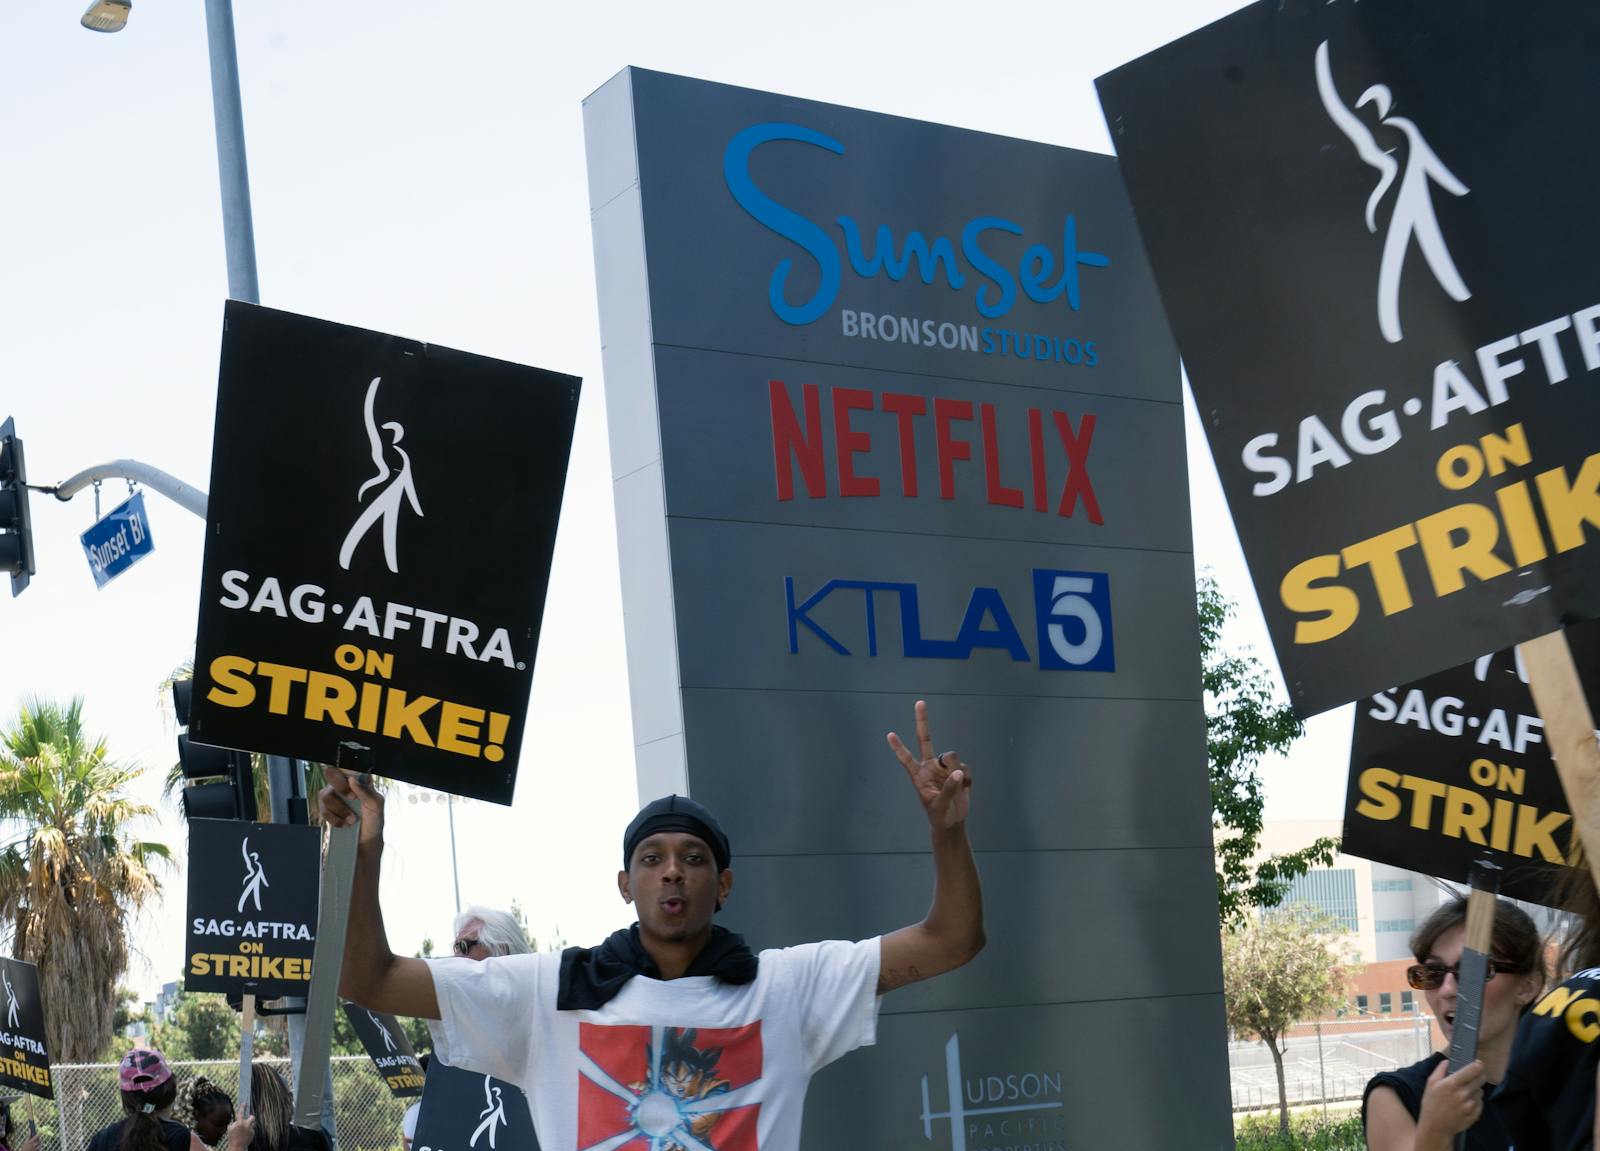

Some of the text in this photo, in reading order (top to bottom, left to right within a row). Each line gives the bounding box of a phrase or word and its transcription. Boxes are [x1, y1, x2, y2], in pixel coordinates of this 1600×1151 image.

[841, 309, 1098, 367] BRONSON STUDIOS
[768, 379, 1104, 526] NETFLIX
[1436, 422, 1533, 491] ON
[90, 511, 146, 573] Sunset Bl
[784, 575, 1103, 666] KTLA 5
[334, 643, 394, 681] ON
[206, 655, 512, 763] STRIKE!
[1468, 758, 1526, 796] ON
[1354, 767, 1581, 868] STRIK
[190, 952, 313, 981] STRIKE!
[239, 941, 264, 954] ON
[14, 1050, 26, 1062] ON
